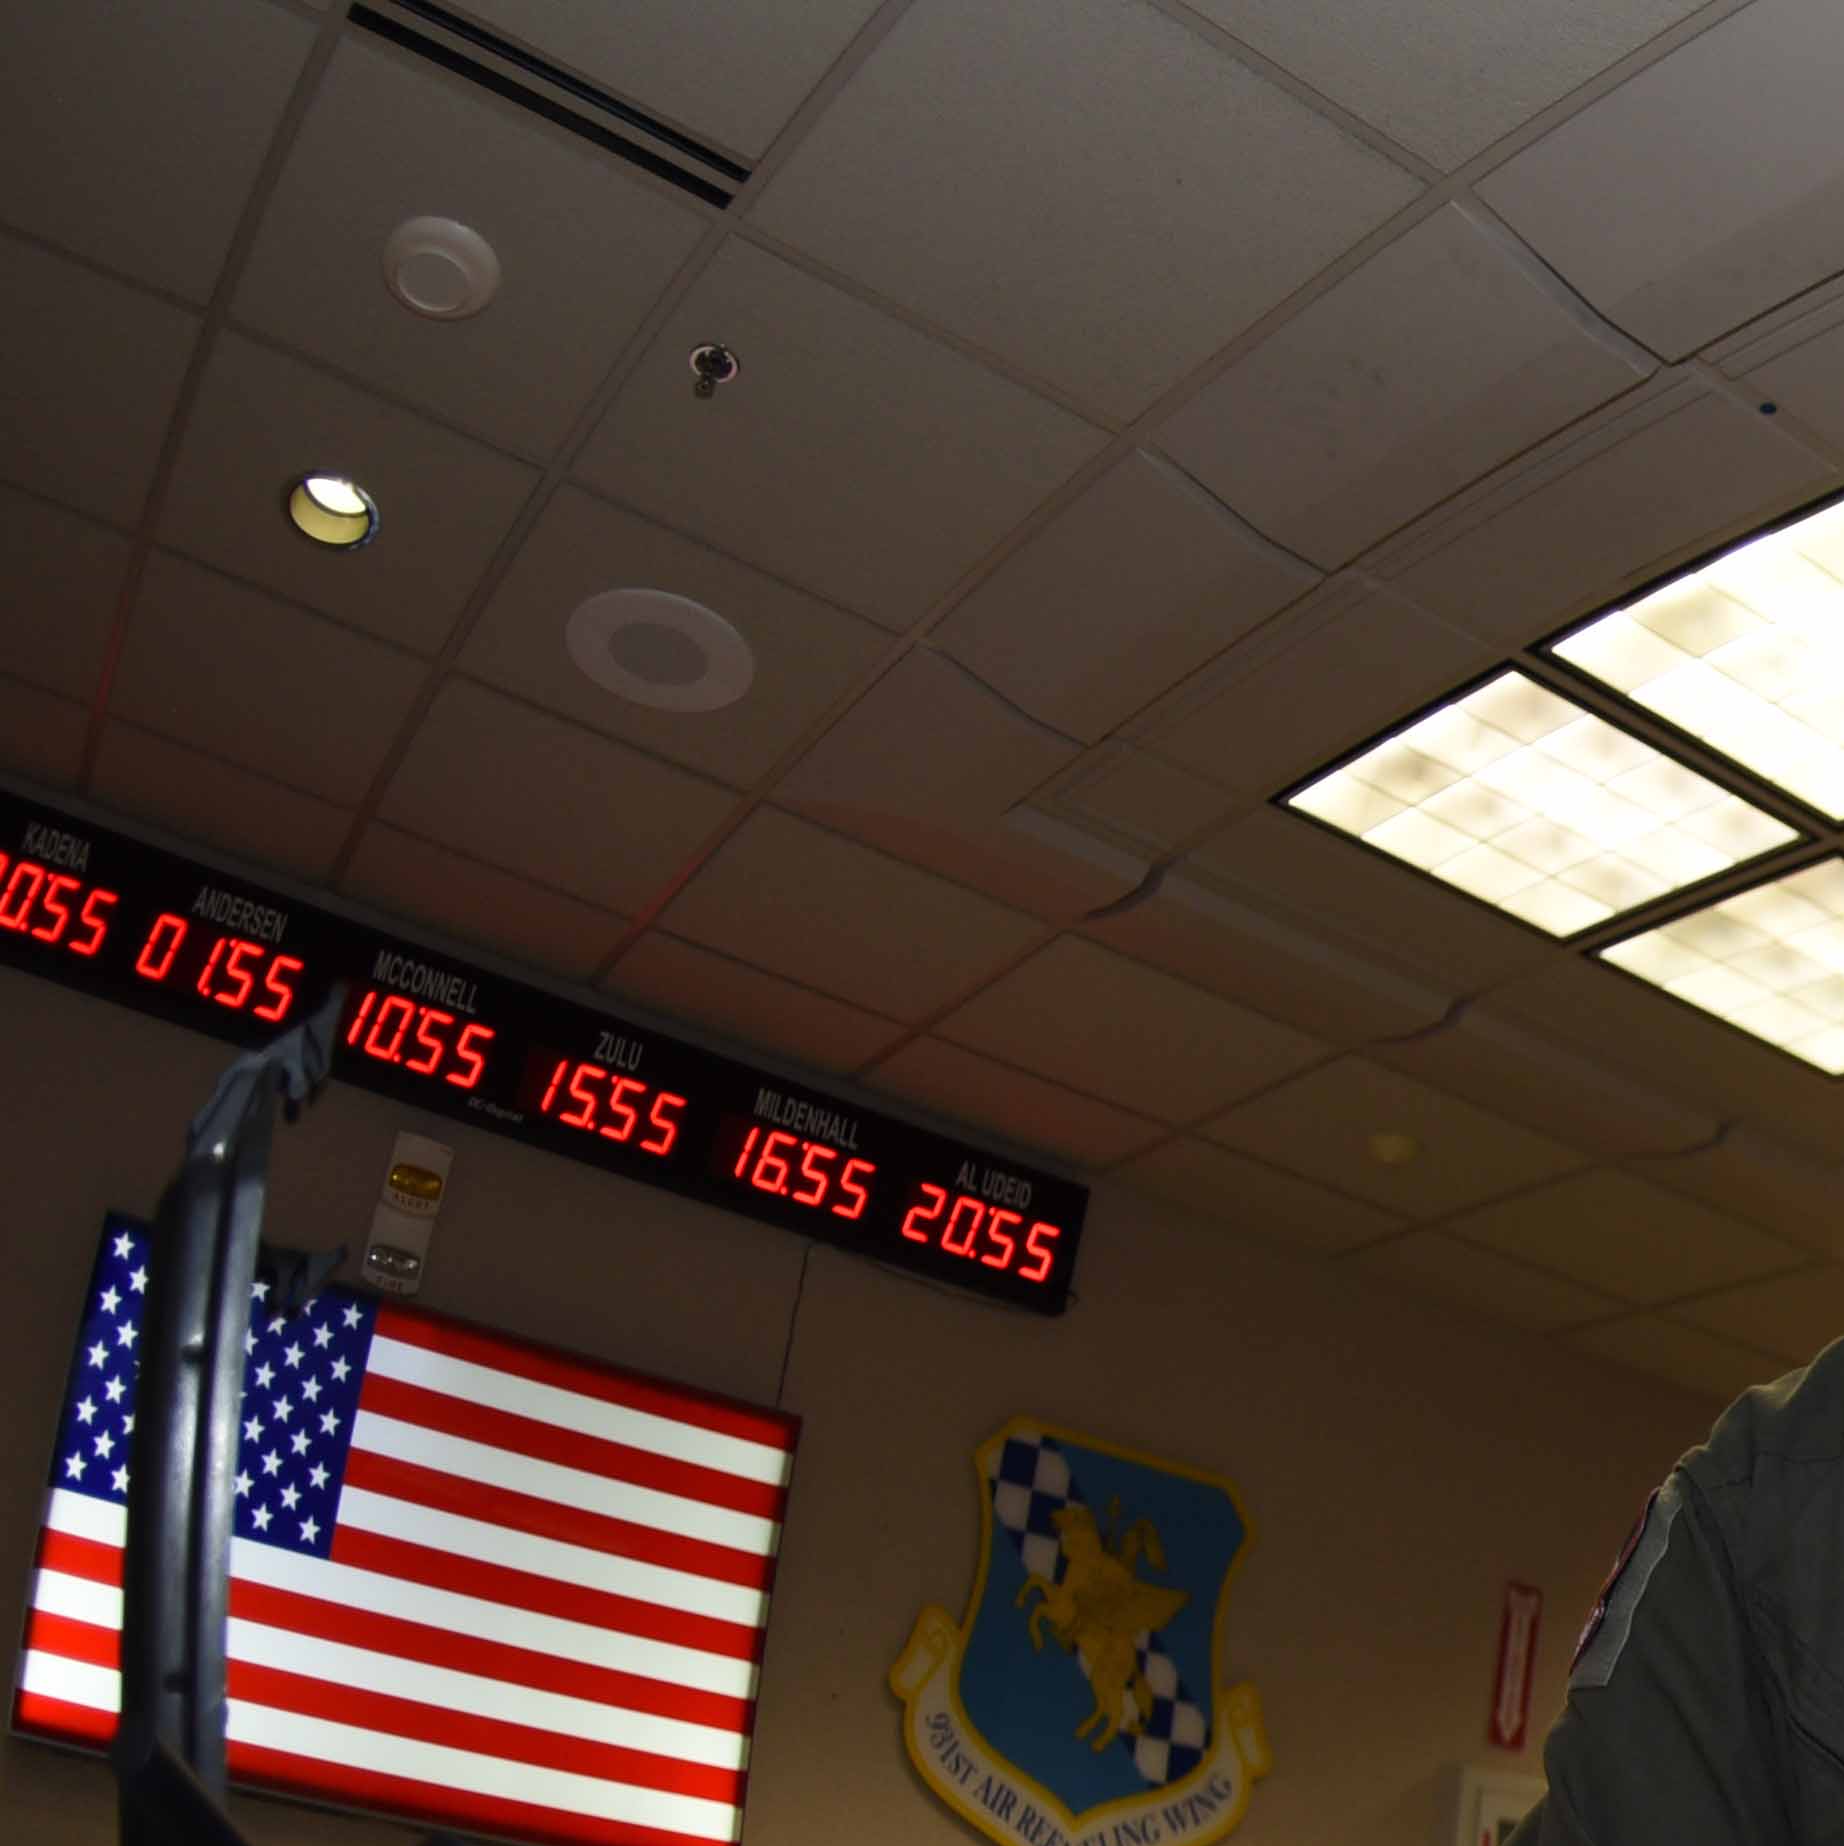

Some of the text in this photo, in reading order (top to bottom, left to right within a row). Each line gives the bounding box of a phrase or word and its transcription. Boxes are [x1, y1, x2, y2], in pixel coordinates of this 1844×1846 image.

[21, 822, 90, 873] KADENA
[193, 884, 288, 944] ANDERSEN
[593, 1030, 643, 1071] ZULU
[753, 1087, 860, 1150] MILDENHALL
[956, 1160, 1032, 1209] AL UDEID
[925, 1711, 978, 1785] 931ST
[973, 1775, 1018, 1828] AIR
[1161, 1771, 1233, 1838] WING
